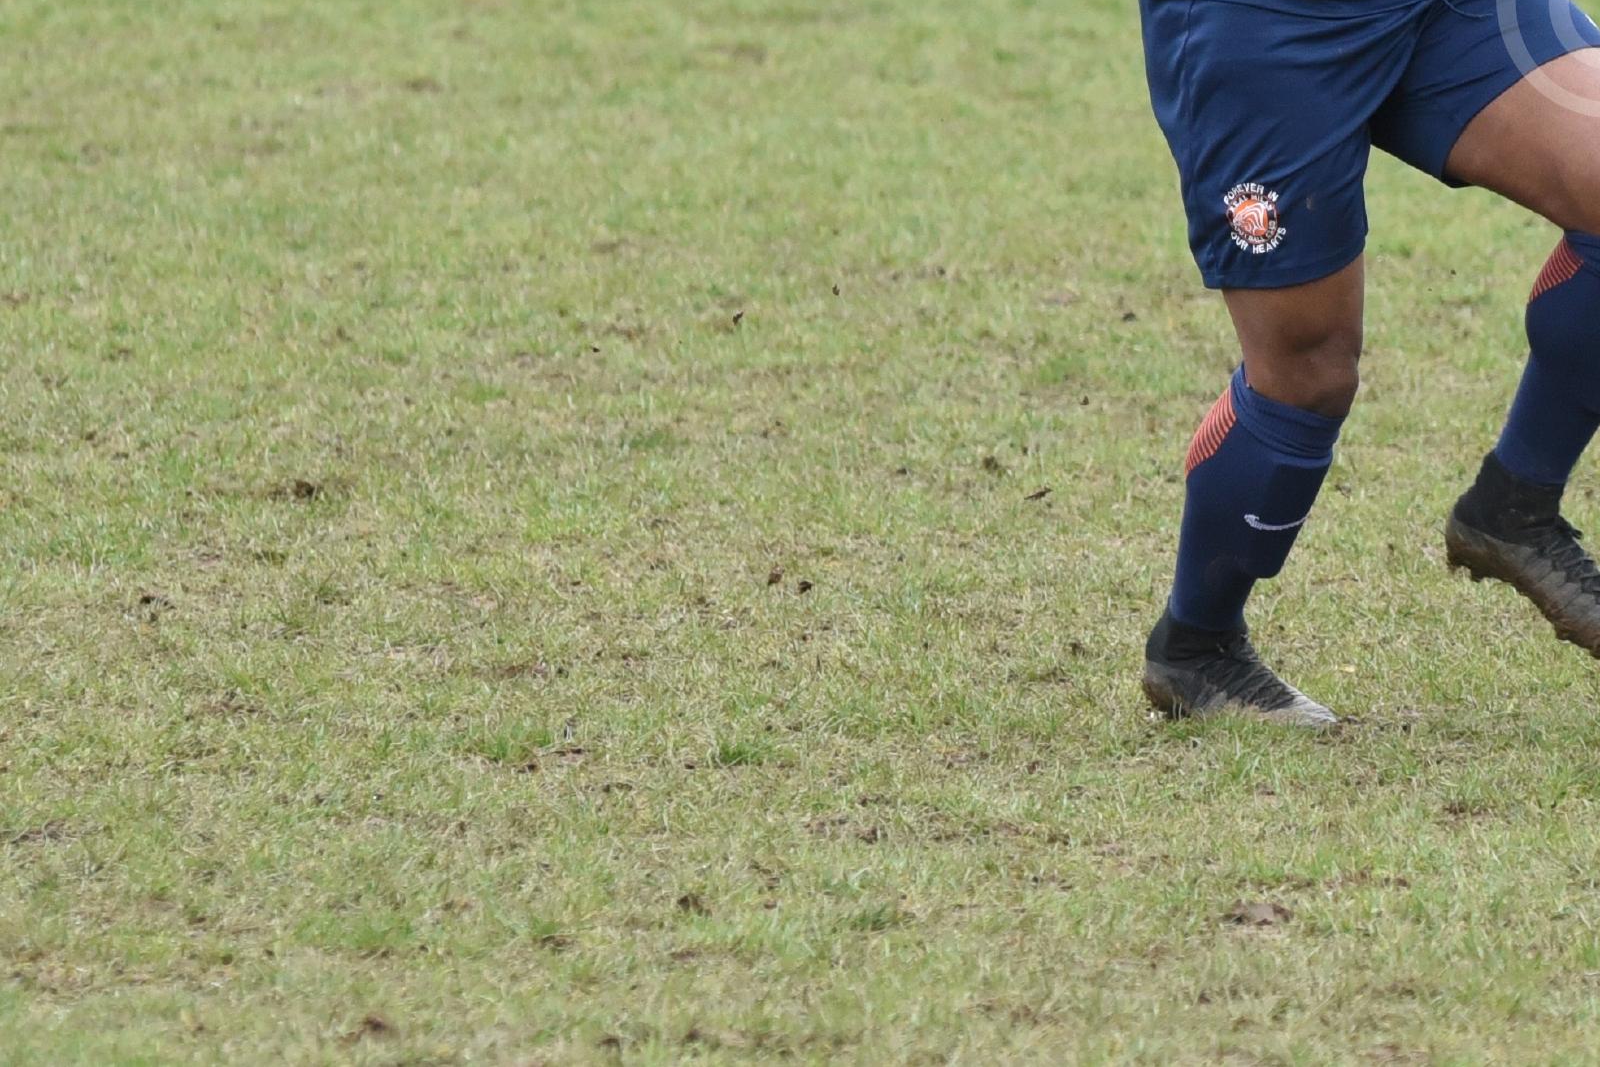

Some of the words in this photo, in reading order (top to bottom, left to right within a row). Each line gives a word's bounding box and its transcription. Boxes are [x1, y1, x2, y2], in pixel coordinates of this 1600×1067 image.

[1224, 183, 1265, 205] FOREVER
[1231, 232, 1249, 250] OUR
[1253, 227, 1286, 254] HEARTS
